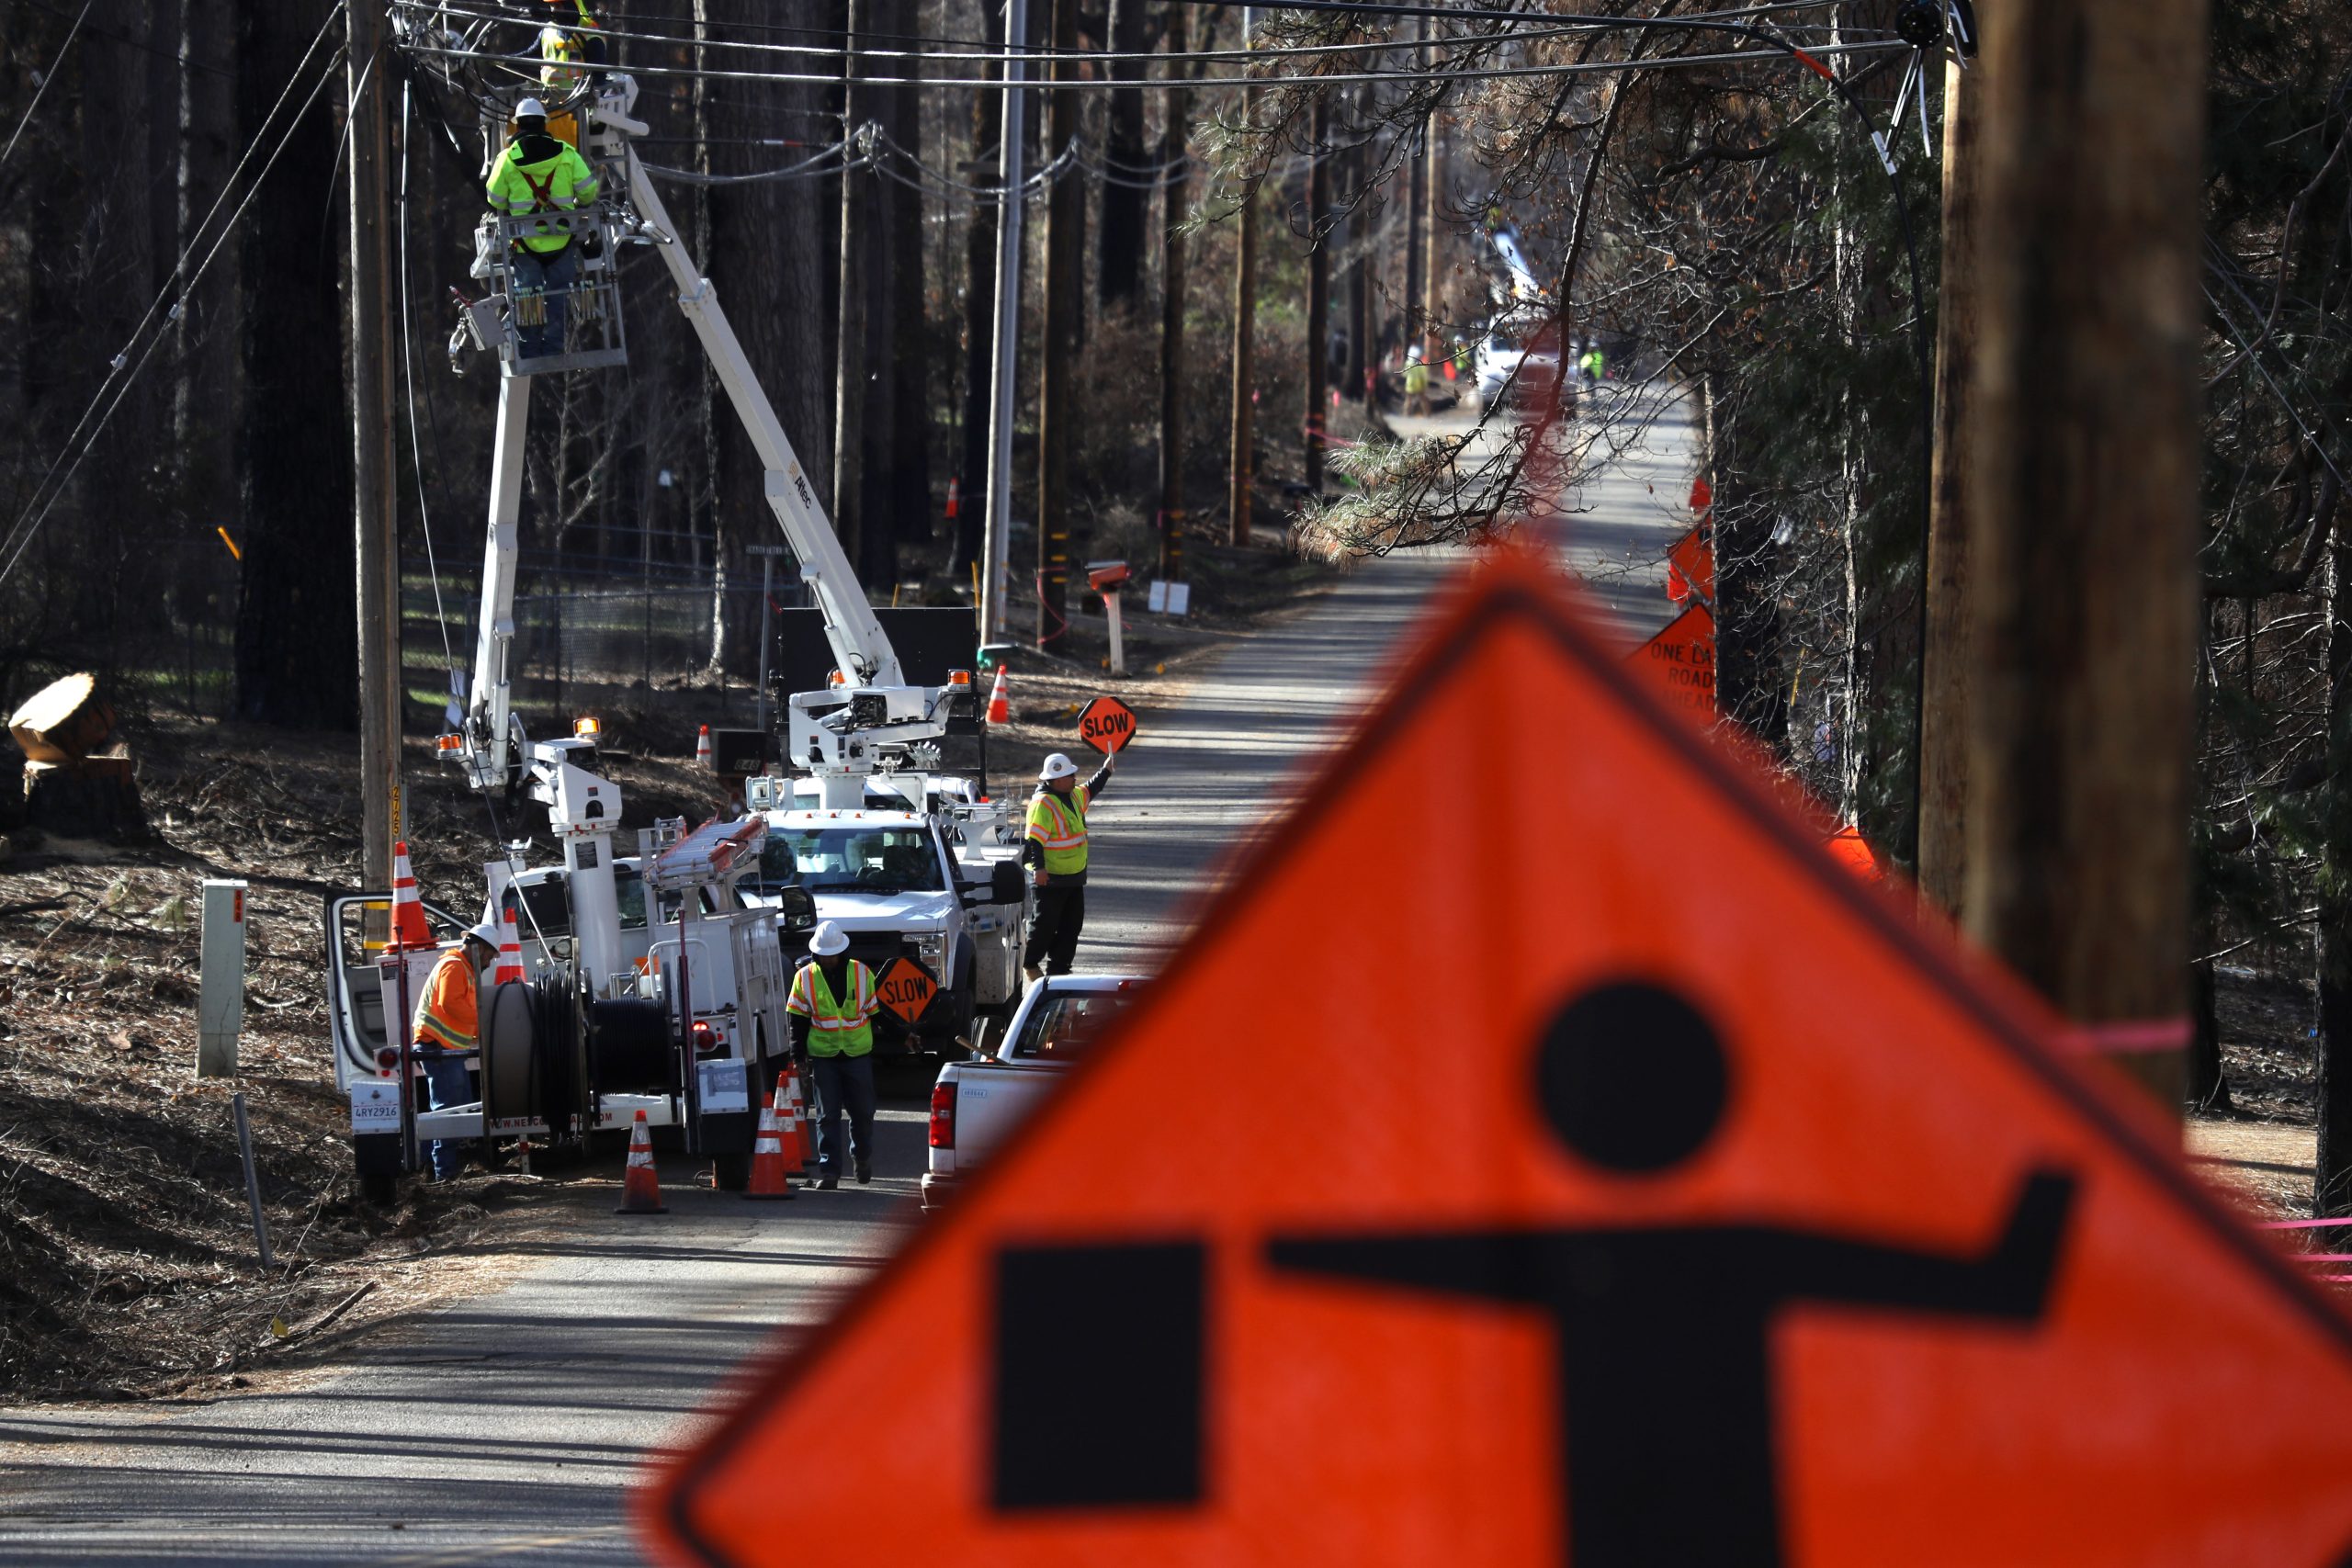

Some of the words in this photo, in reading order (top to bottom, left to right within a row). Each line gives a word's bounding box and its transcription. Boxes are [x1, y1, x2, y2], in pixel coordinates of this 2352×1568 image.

[795, 475, 811, 509] Altec
[774, 646, 793, 665] LA
[1651, 642, 1685, 662] ONE
[1668, 667, 1713, 689] ROAD
[1084, 712, 1128, 738] SLOW
[884, 976, 928, 1005] SLOW
[356, 1106, 397, 1118] 4RY2916
